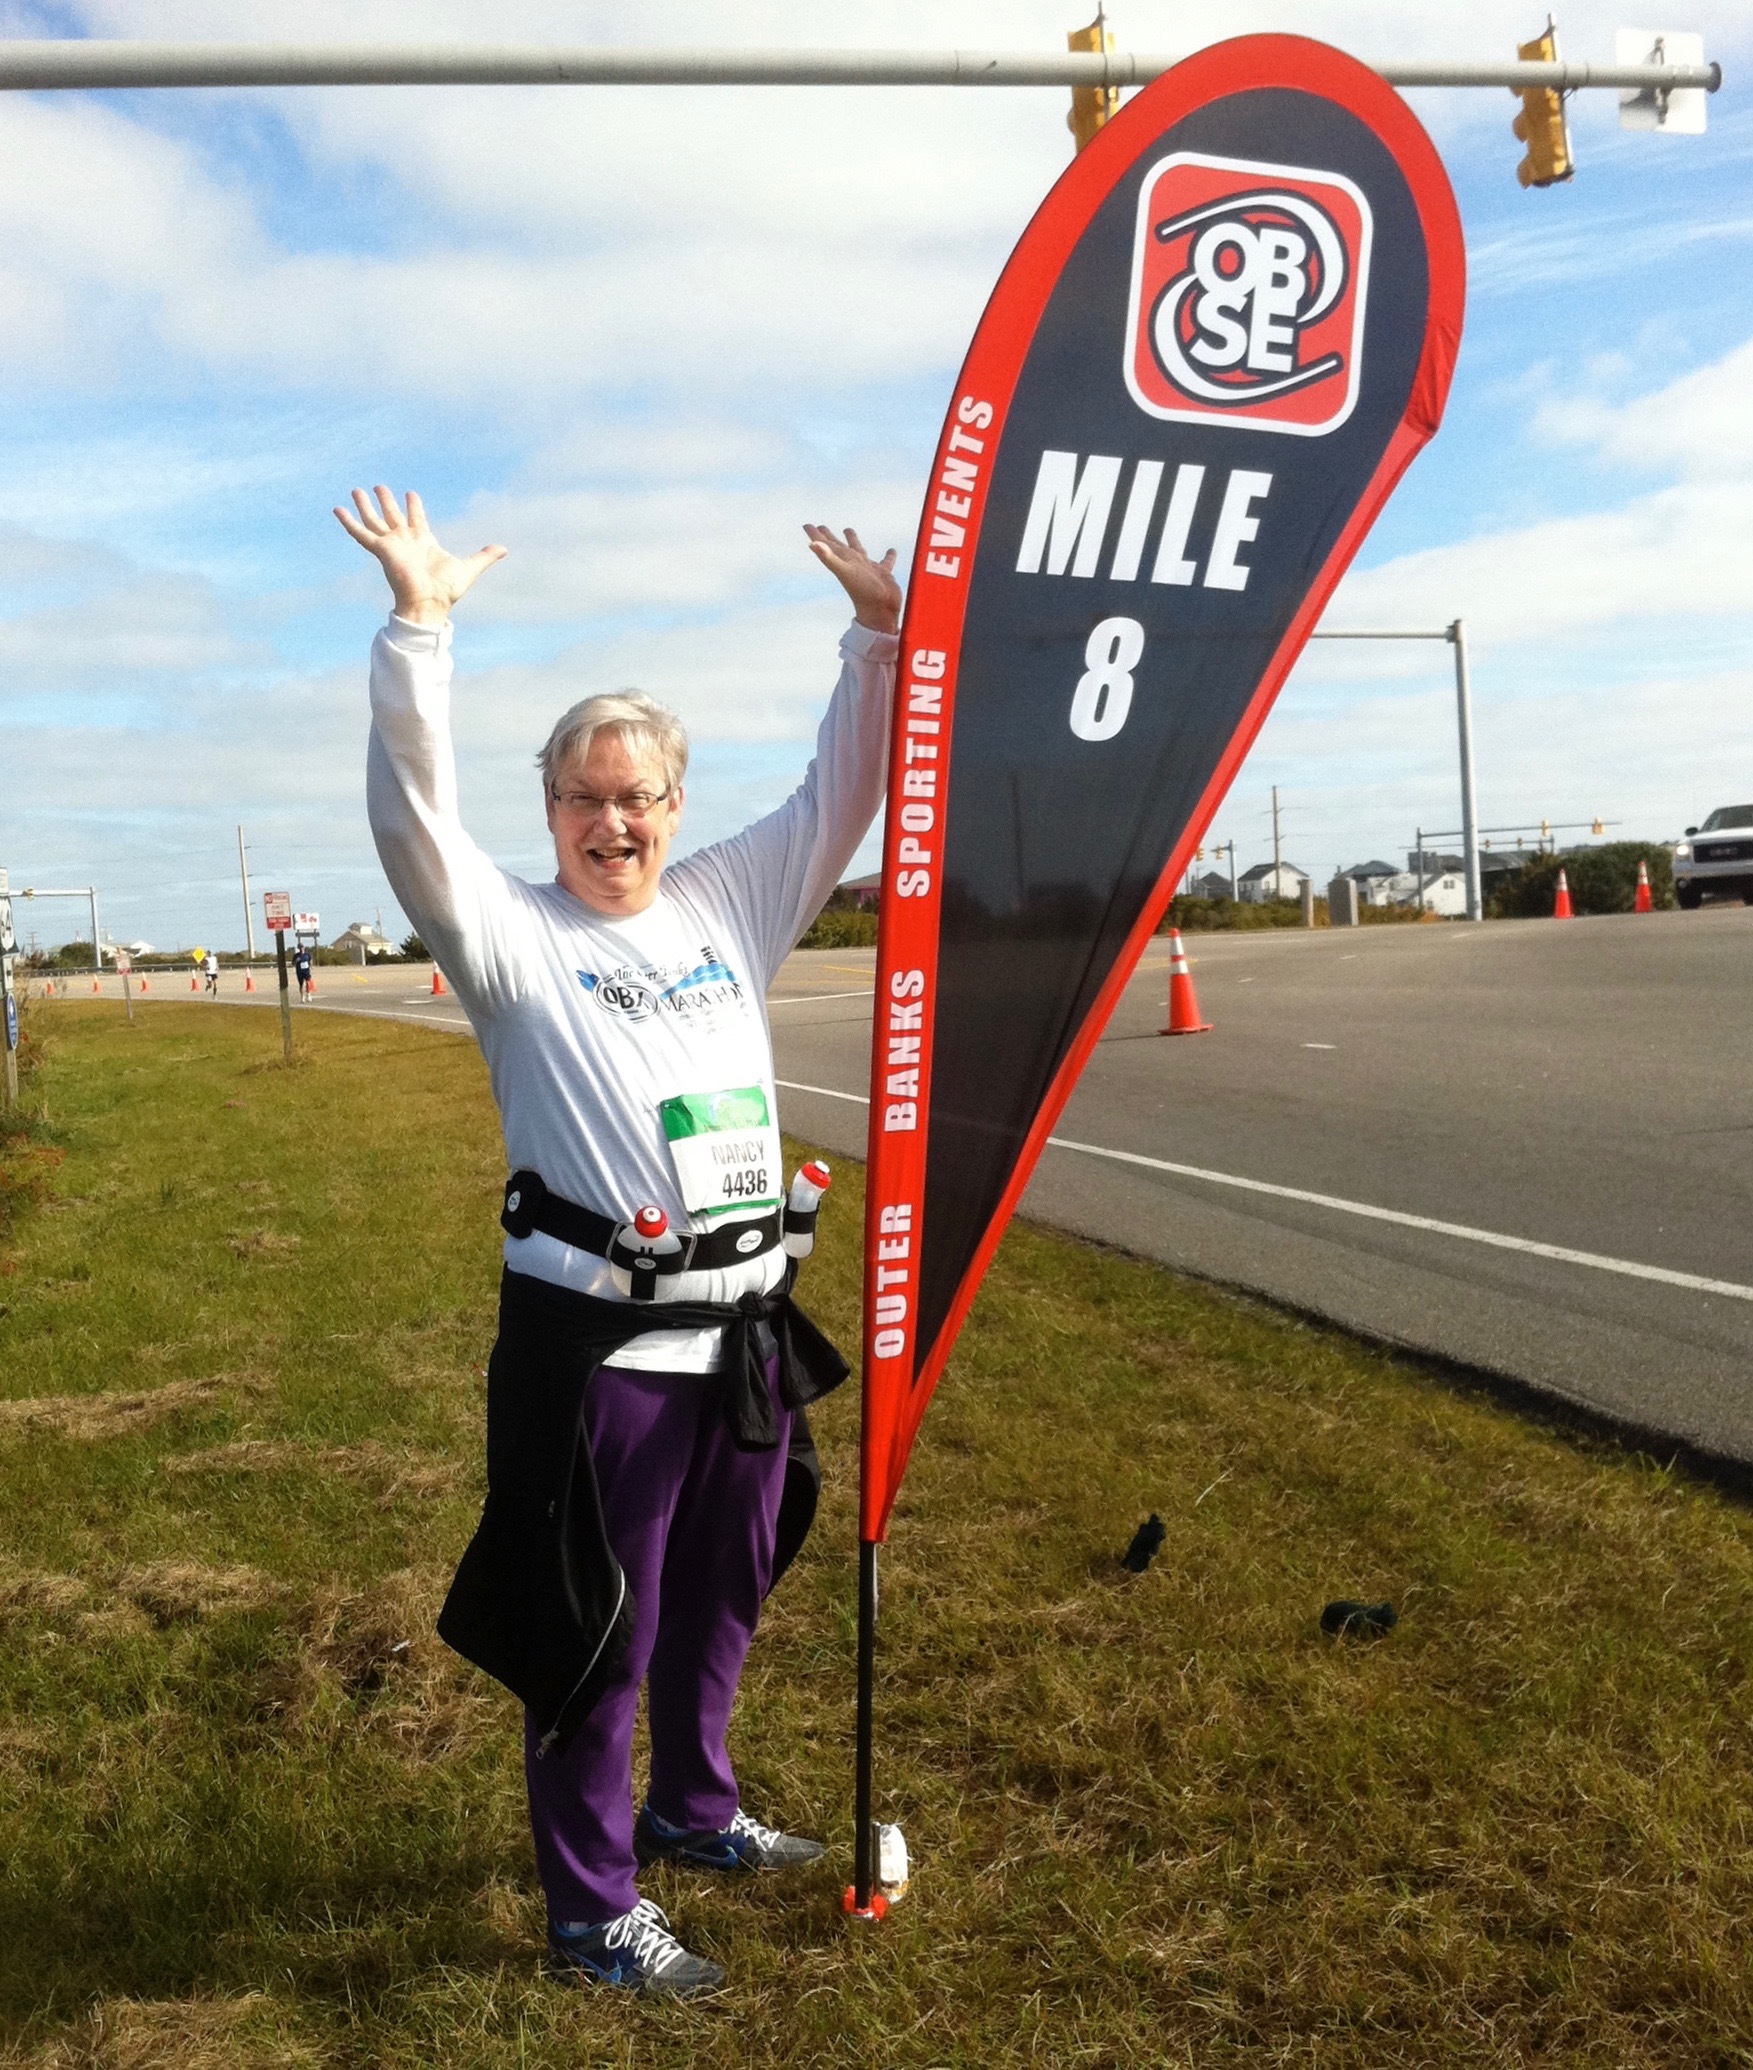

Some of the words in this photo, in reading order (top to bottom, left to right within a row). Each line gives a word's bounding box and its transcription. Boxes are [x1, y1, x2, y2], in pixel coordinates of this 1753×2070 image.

[925, 395, 994, 579] EVENTS
[1015, 450, 1273, 591] MILE
[1069, 616, 1145, 741] 8
[896, 649, 946, 898] SPORTING
[884, 969, 925, 1132] BANKS
[711, 1139, 765, 1165] NANCY
[722, 1168, 768, 1198] 4436
[874, 1204, 912, 1359] OUTER
